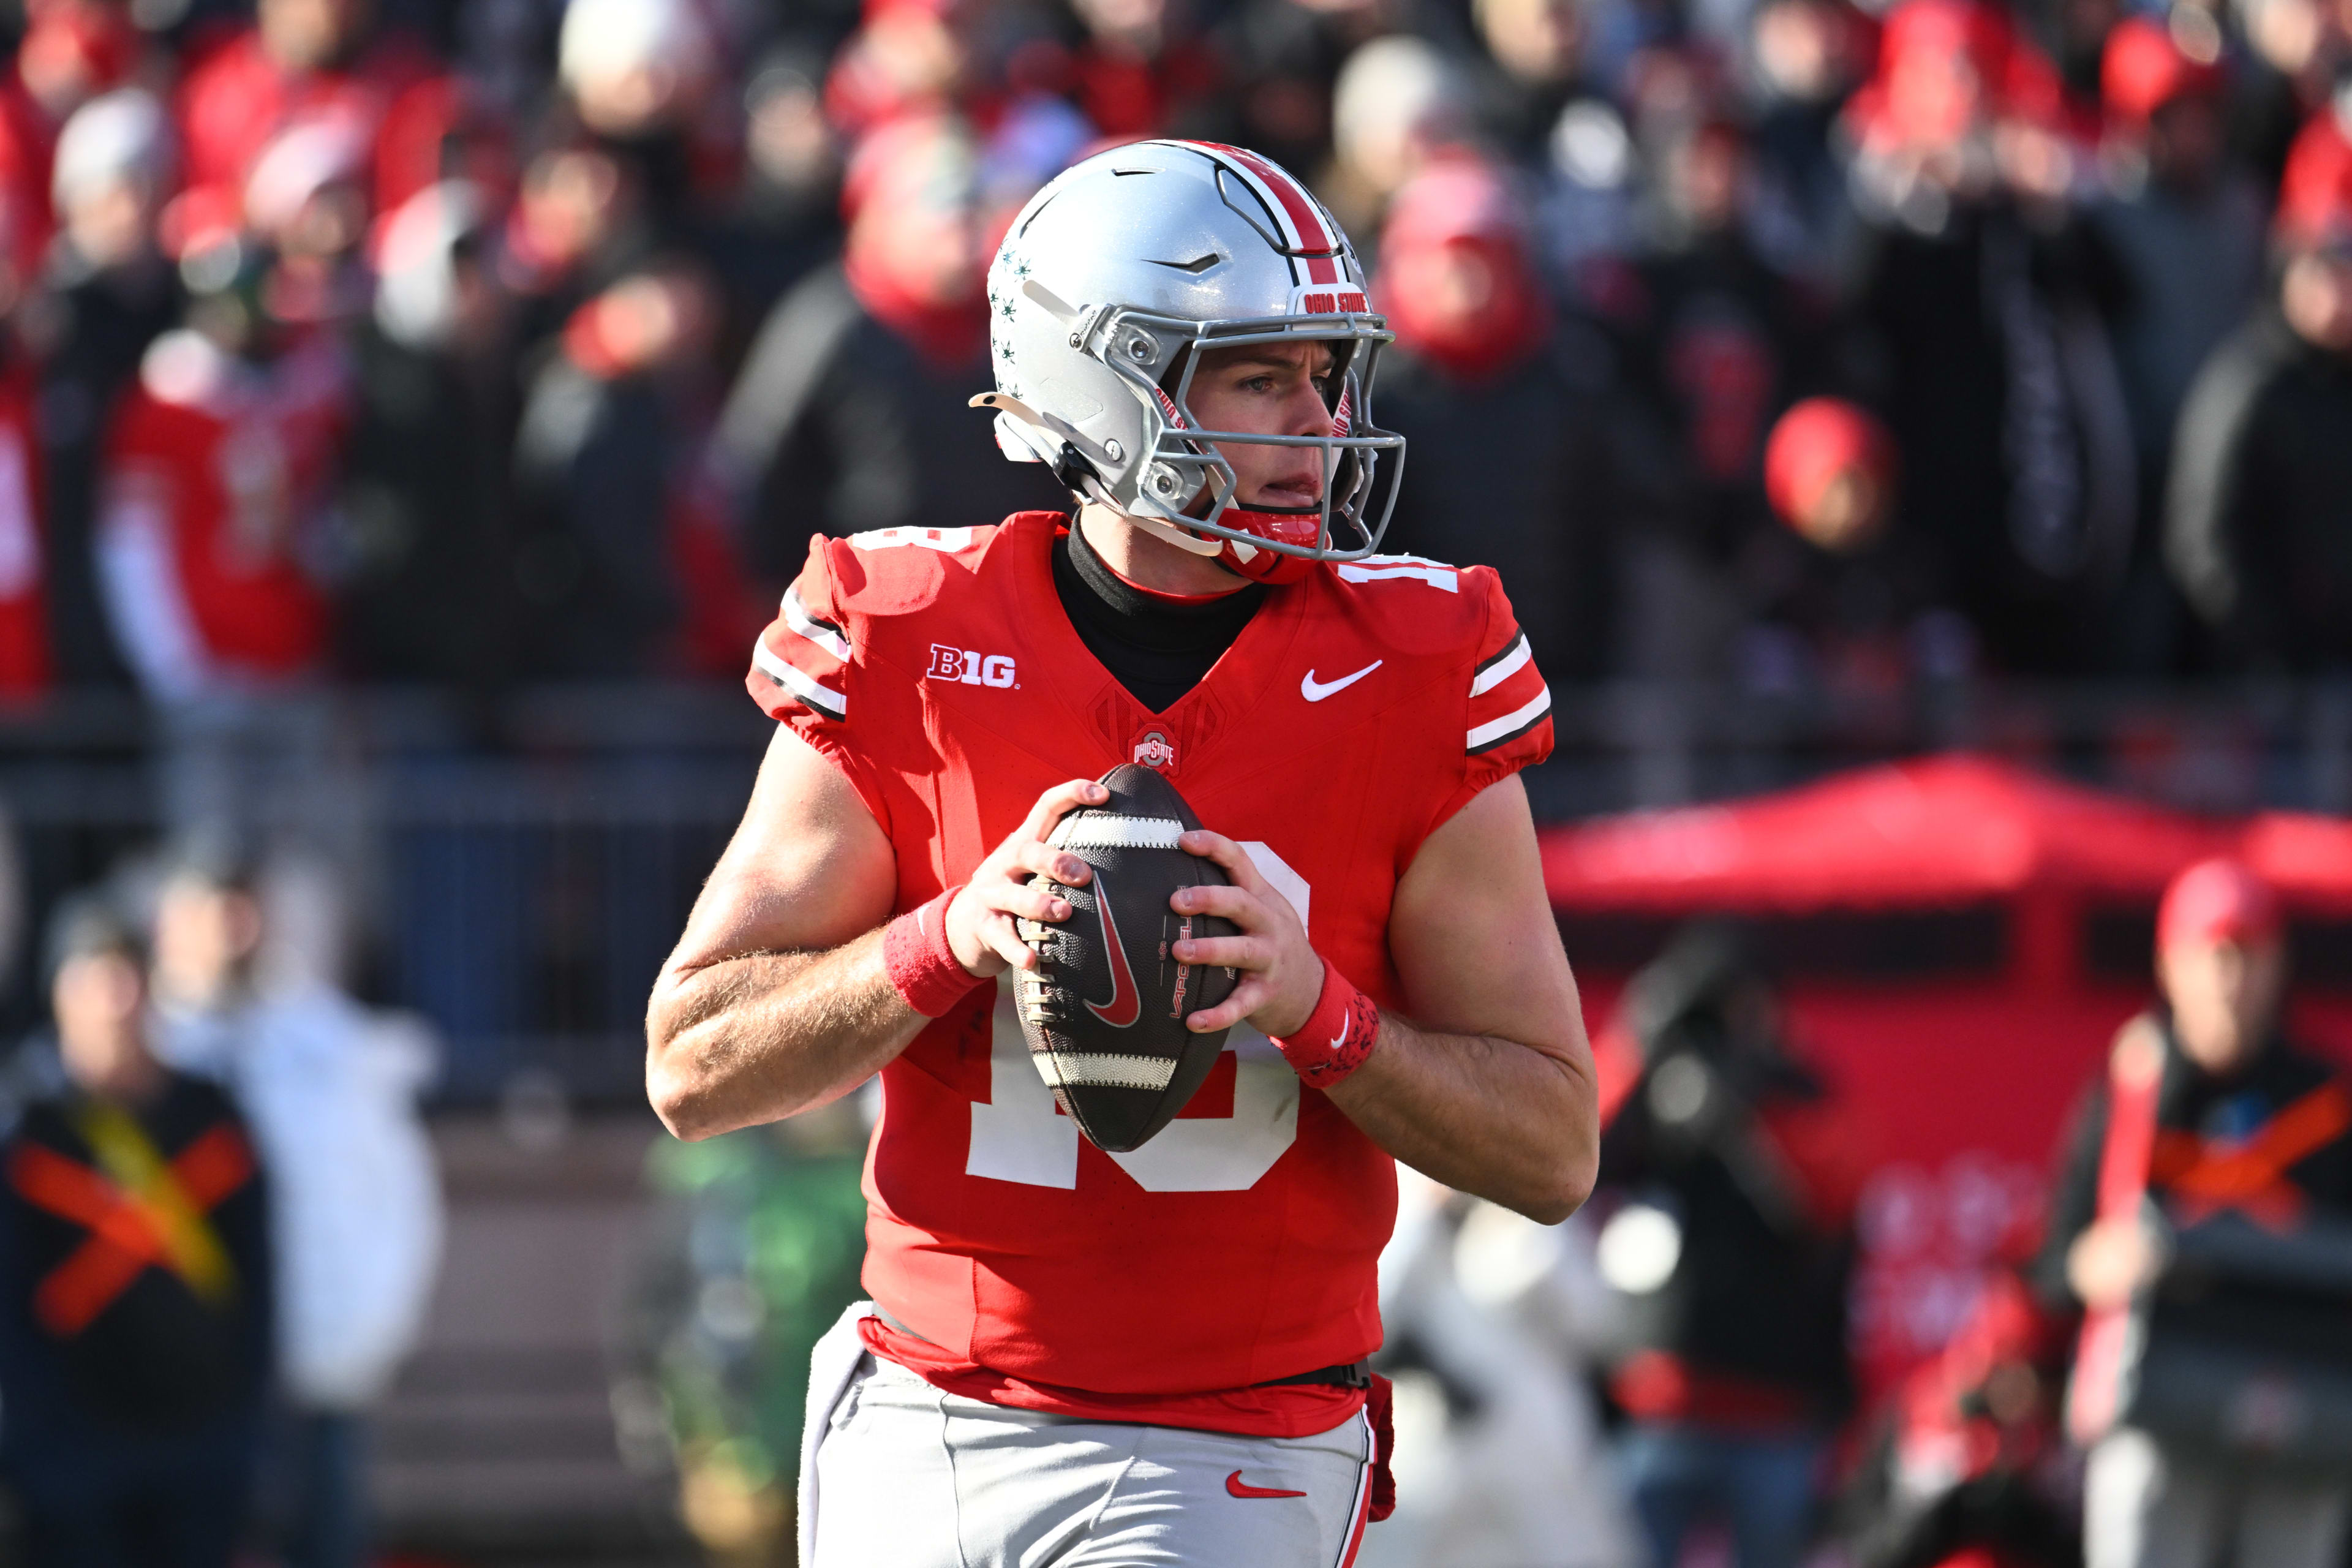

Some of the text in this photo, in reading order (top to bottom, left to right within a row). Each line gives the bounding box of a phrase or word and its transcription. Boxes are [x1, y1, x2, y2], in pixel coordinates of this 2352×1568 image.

[1304, 292, 1368, 314] OHIO STATE
[1332, 418, 1349, 437] HIO
[1169, 963, 1190, 1019] VAPO
